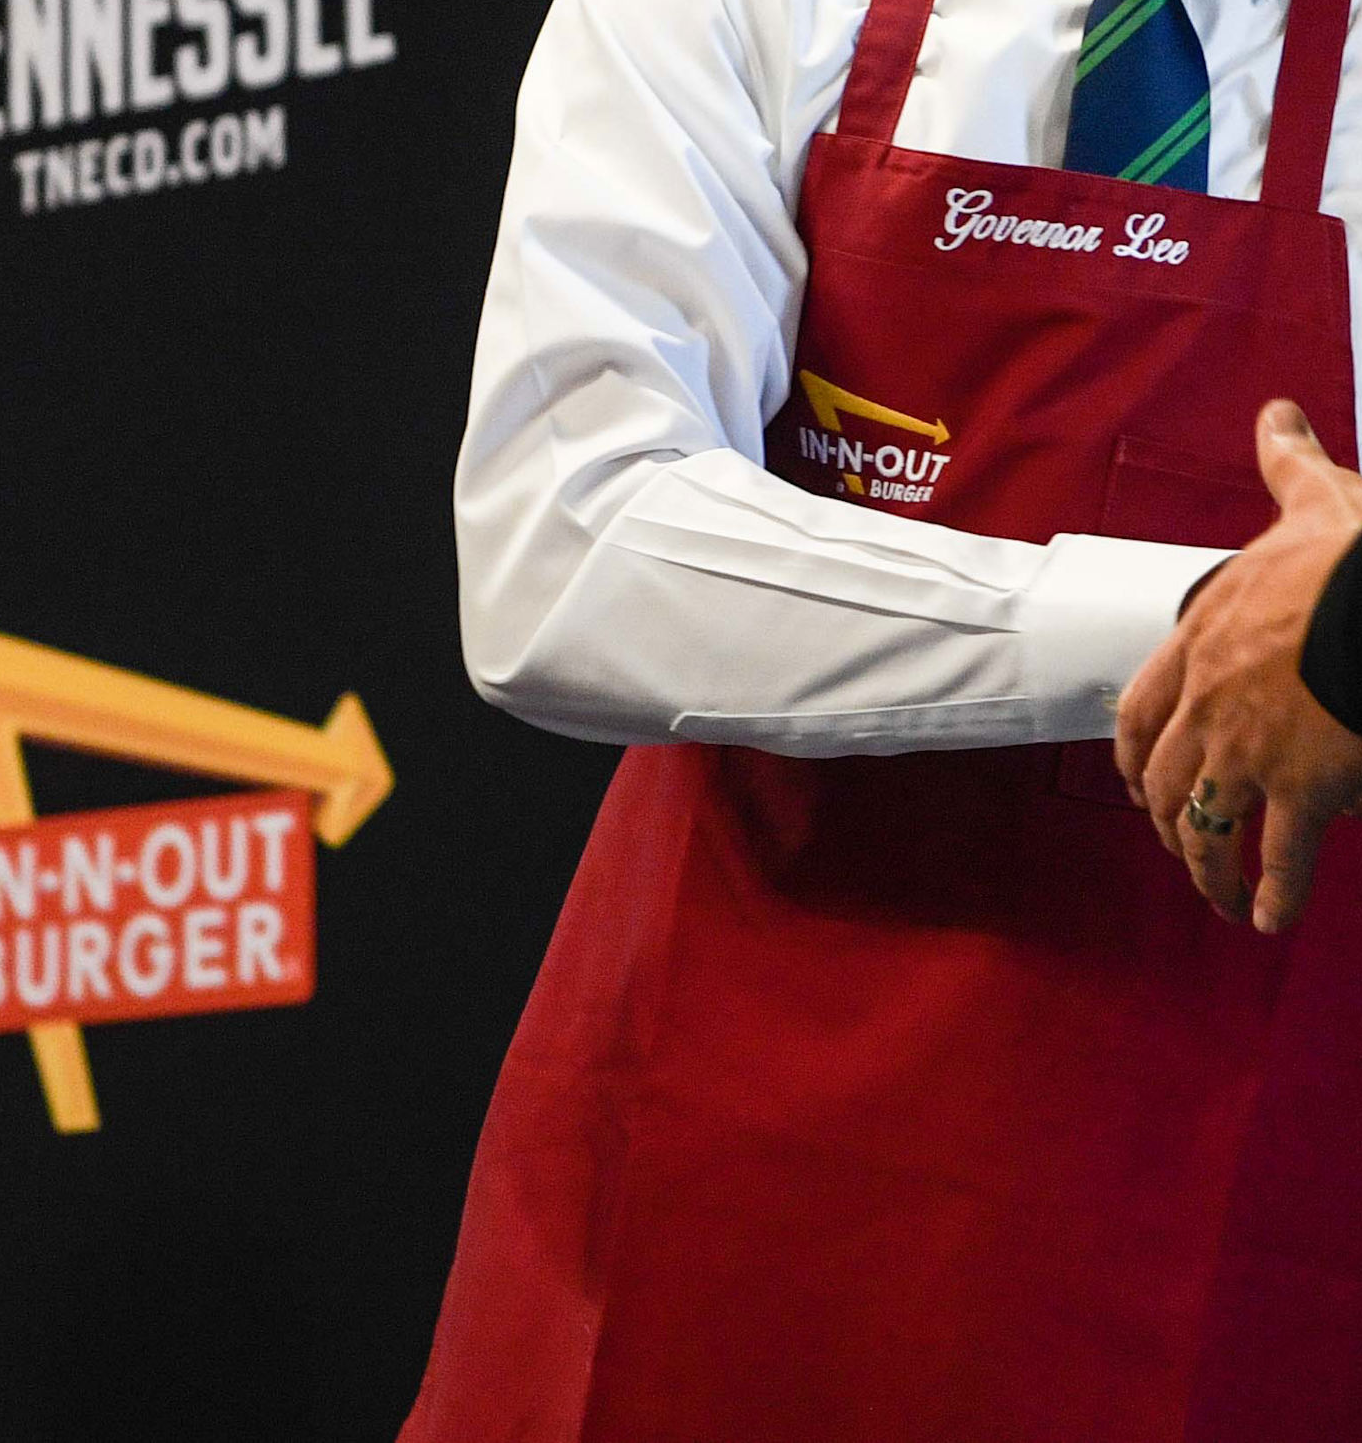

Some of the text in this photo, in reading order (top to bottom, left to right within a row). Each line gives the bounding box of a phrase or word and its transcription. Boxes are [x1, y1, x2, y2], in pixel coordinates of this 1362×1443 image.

[14, 103, 288, 215] TNECD.COM
[934, 187, 1190, 265] Governor Lee
[799, 426, 952, 484] IN-N-OUT
[869, 478, 935, 503] BURGER
